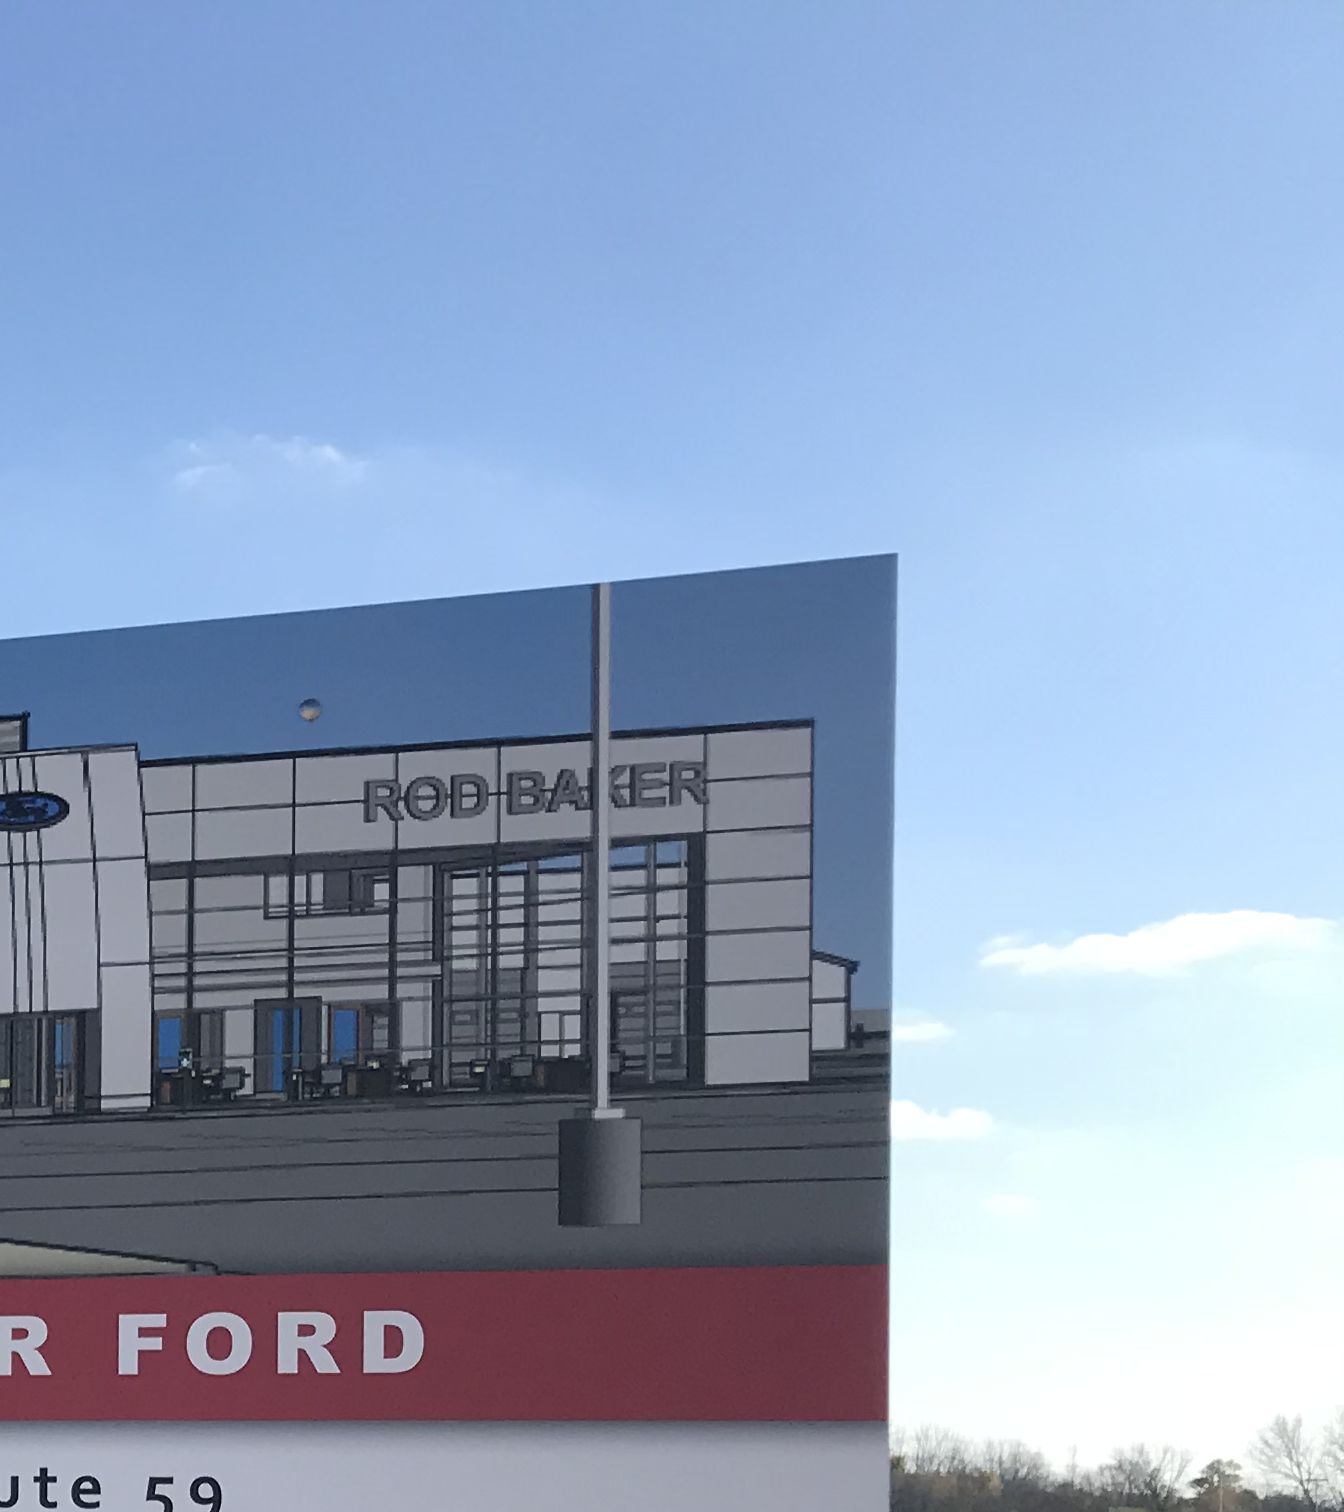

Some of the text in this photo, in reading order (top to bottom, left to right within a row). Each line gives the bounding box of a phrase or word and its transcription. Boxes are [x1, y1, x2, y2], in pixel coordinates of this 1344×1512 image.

[363, 760, 709, 823] ROD BAKER
[119, 1311, 424, 1375] FORD
